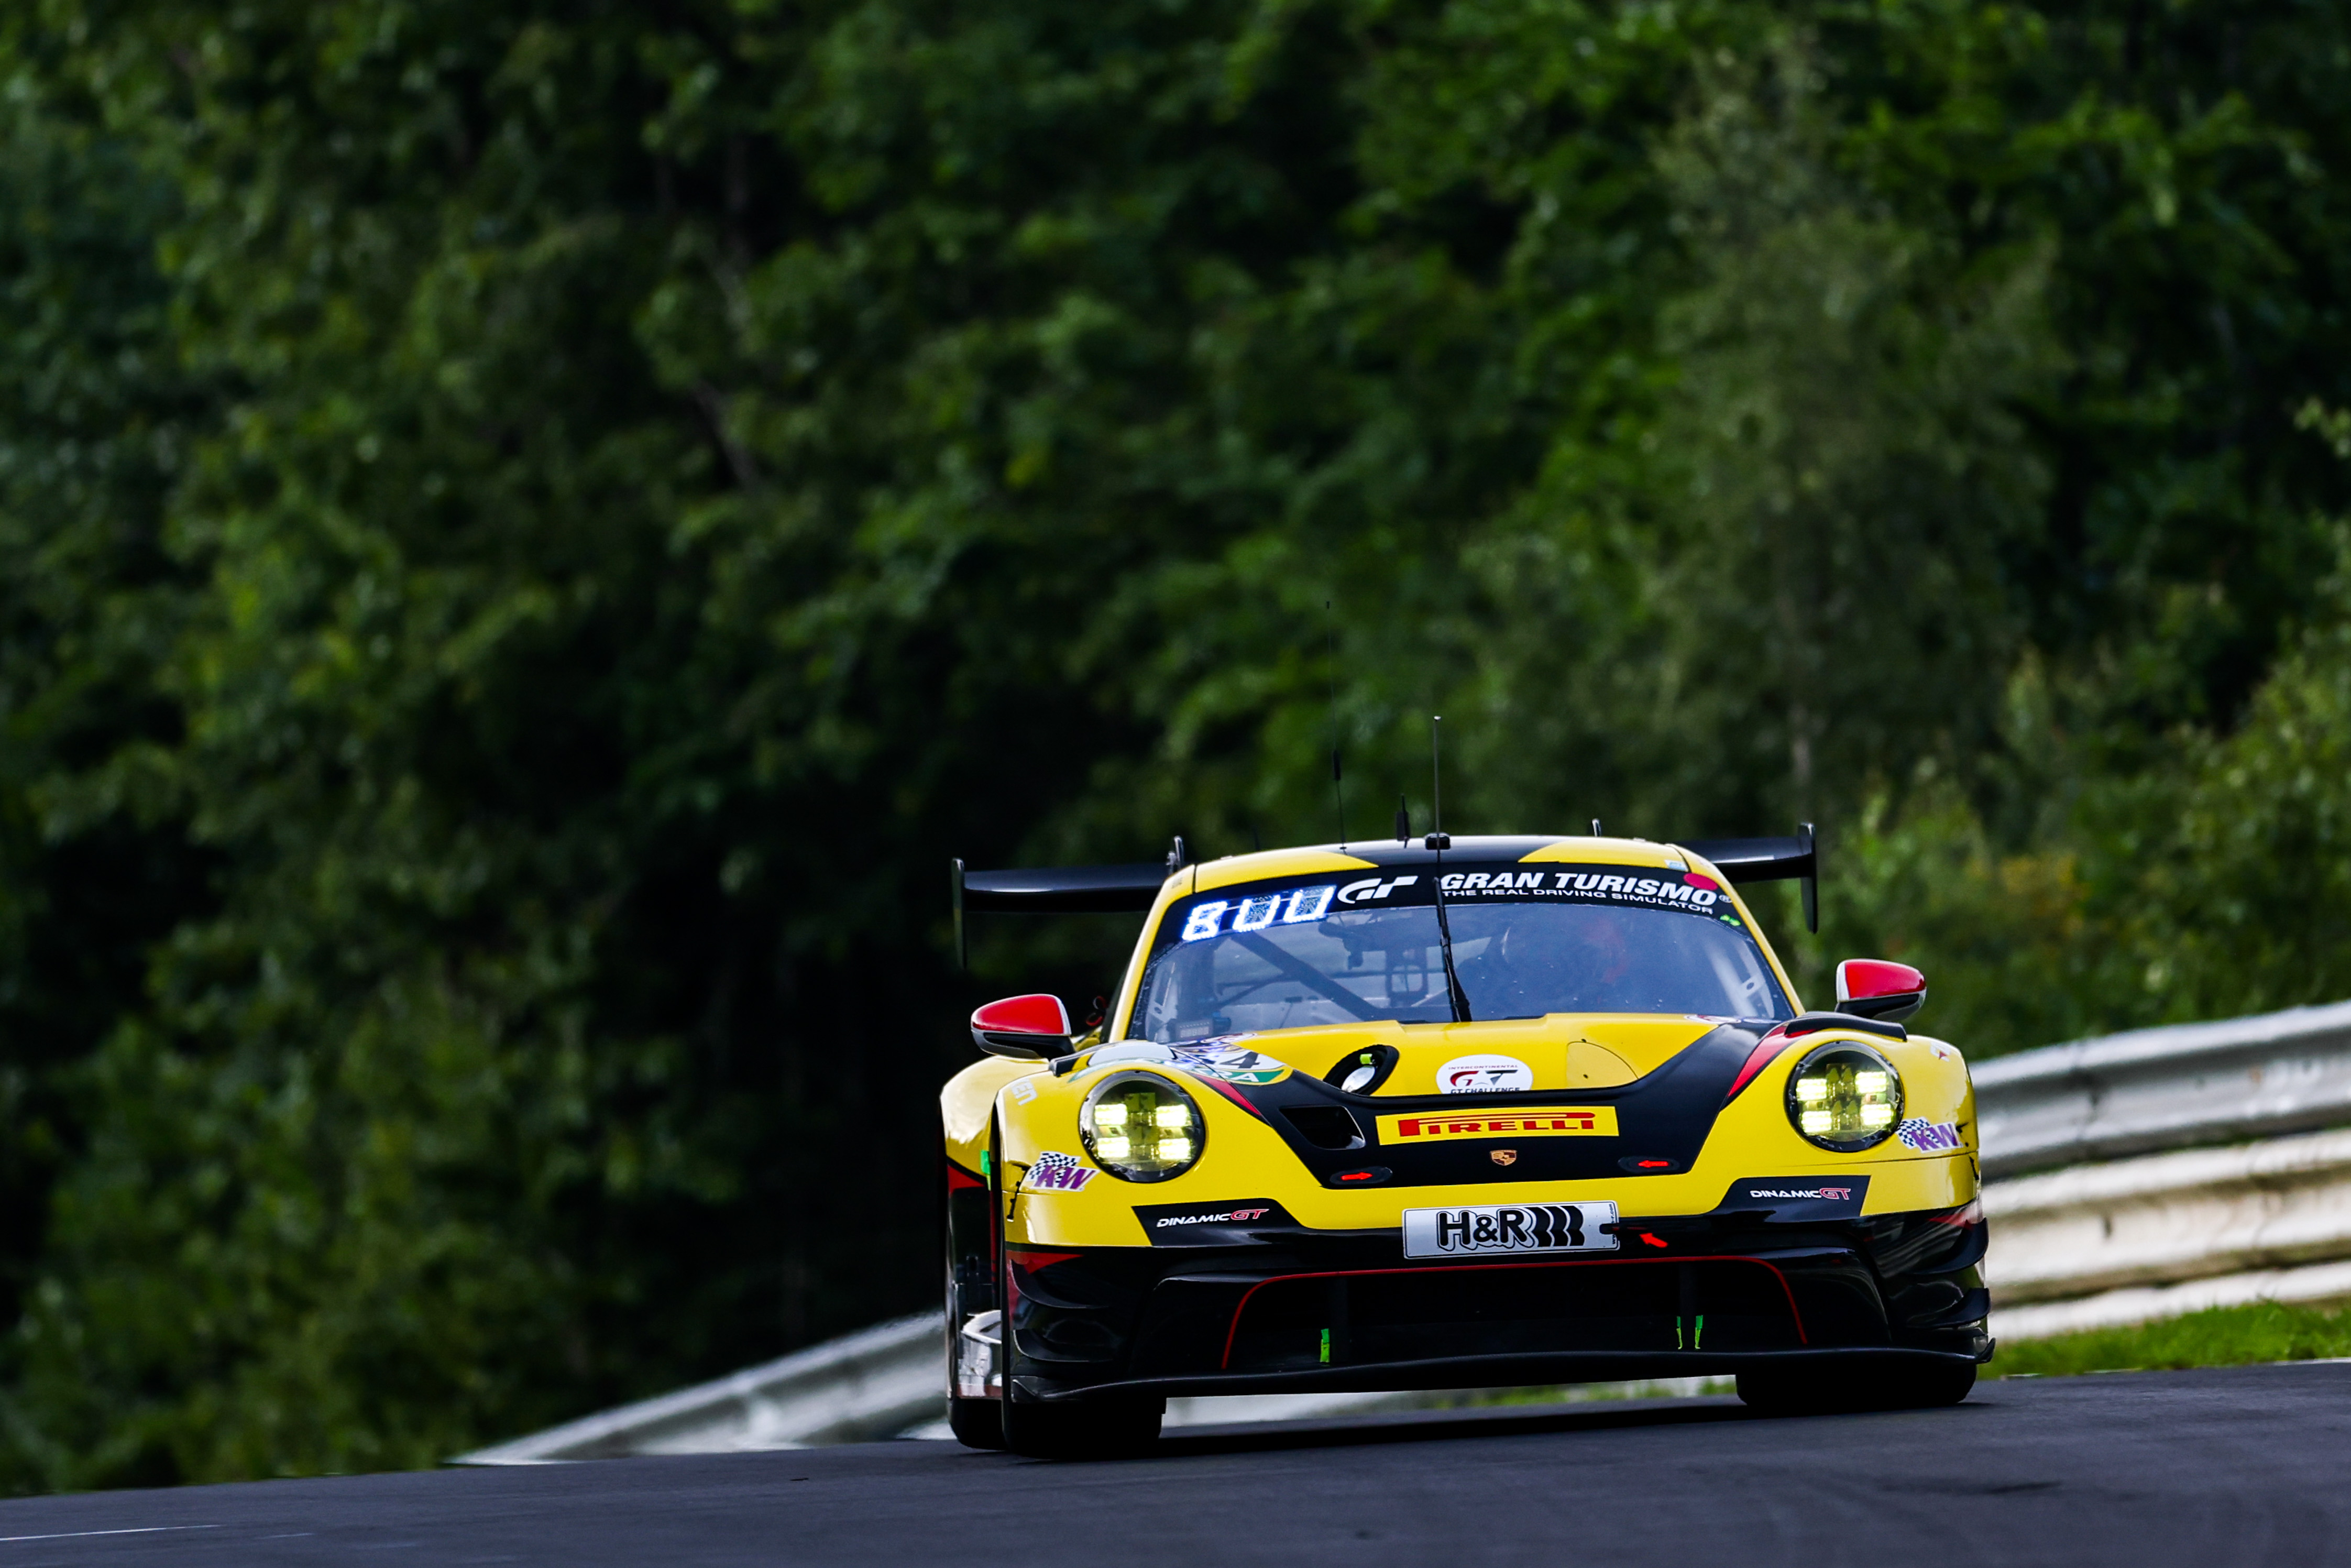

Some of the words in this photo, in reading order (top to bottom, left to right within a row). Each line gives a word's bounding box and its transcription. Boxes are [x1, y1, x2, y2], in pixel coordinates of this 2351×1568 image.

[1441, 872, 1545, 890] GRAN
[1554, 873, 1718, 906] TURISMO
[1533, 889, 1607, 898] DRIVING
[1611, 892, 1713, 915] SIMULATOR
[1398, 1112, 1596, 1137] PIRELLI
[1909, 1123, 1959, 1151] KW
[1034, 1164, 1097, 1190] KW
